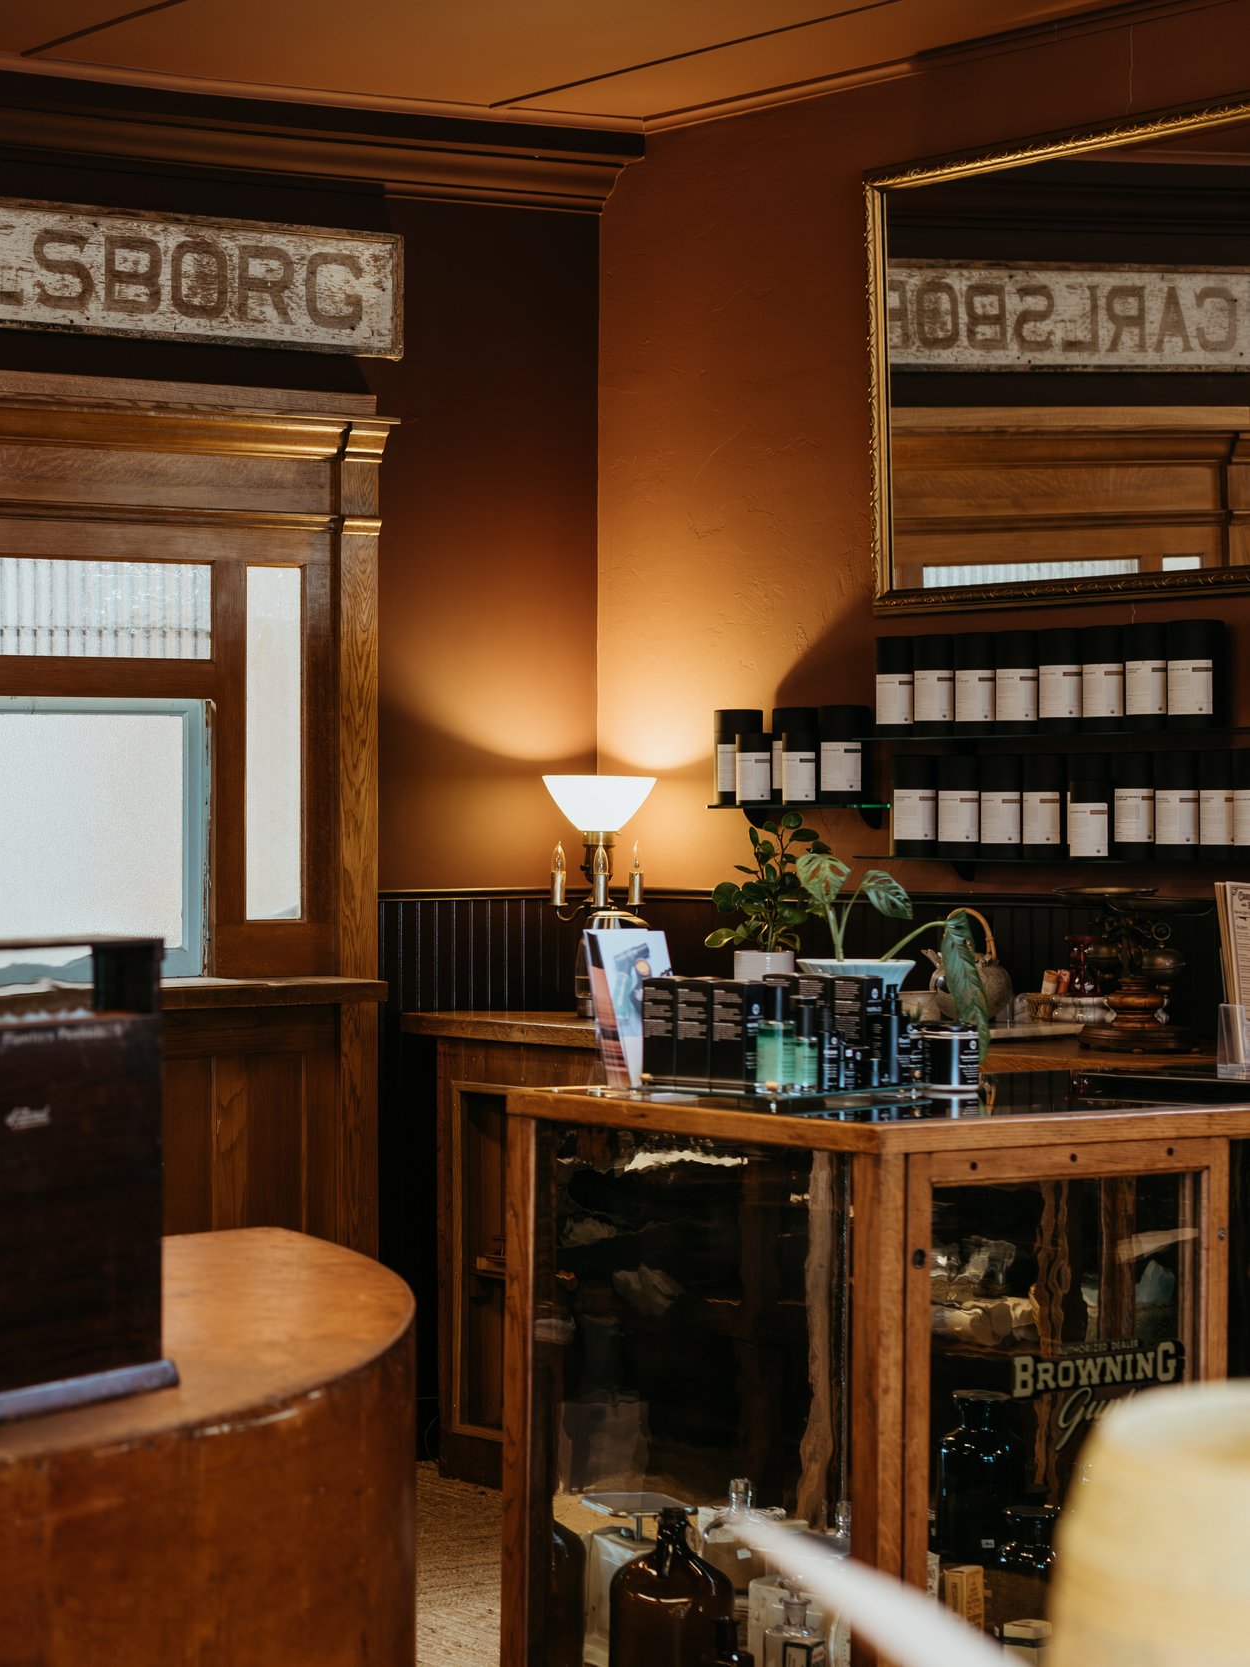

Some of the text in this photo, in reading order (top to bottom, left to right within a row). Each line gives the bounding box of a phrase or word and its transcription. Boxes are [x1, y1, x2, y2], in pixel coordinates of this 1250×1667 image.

[1057, 1340, 1139, 1355] AUTHORIZED DEALER
[1012, 1341, 1177, 1398] BROWNING
